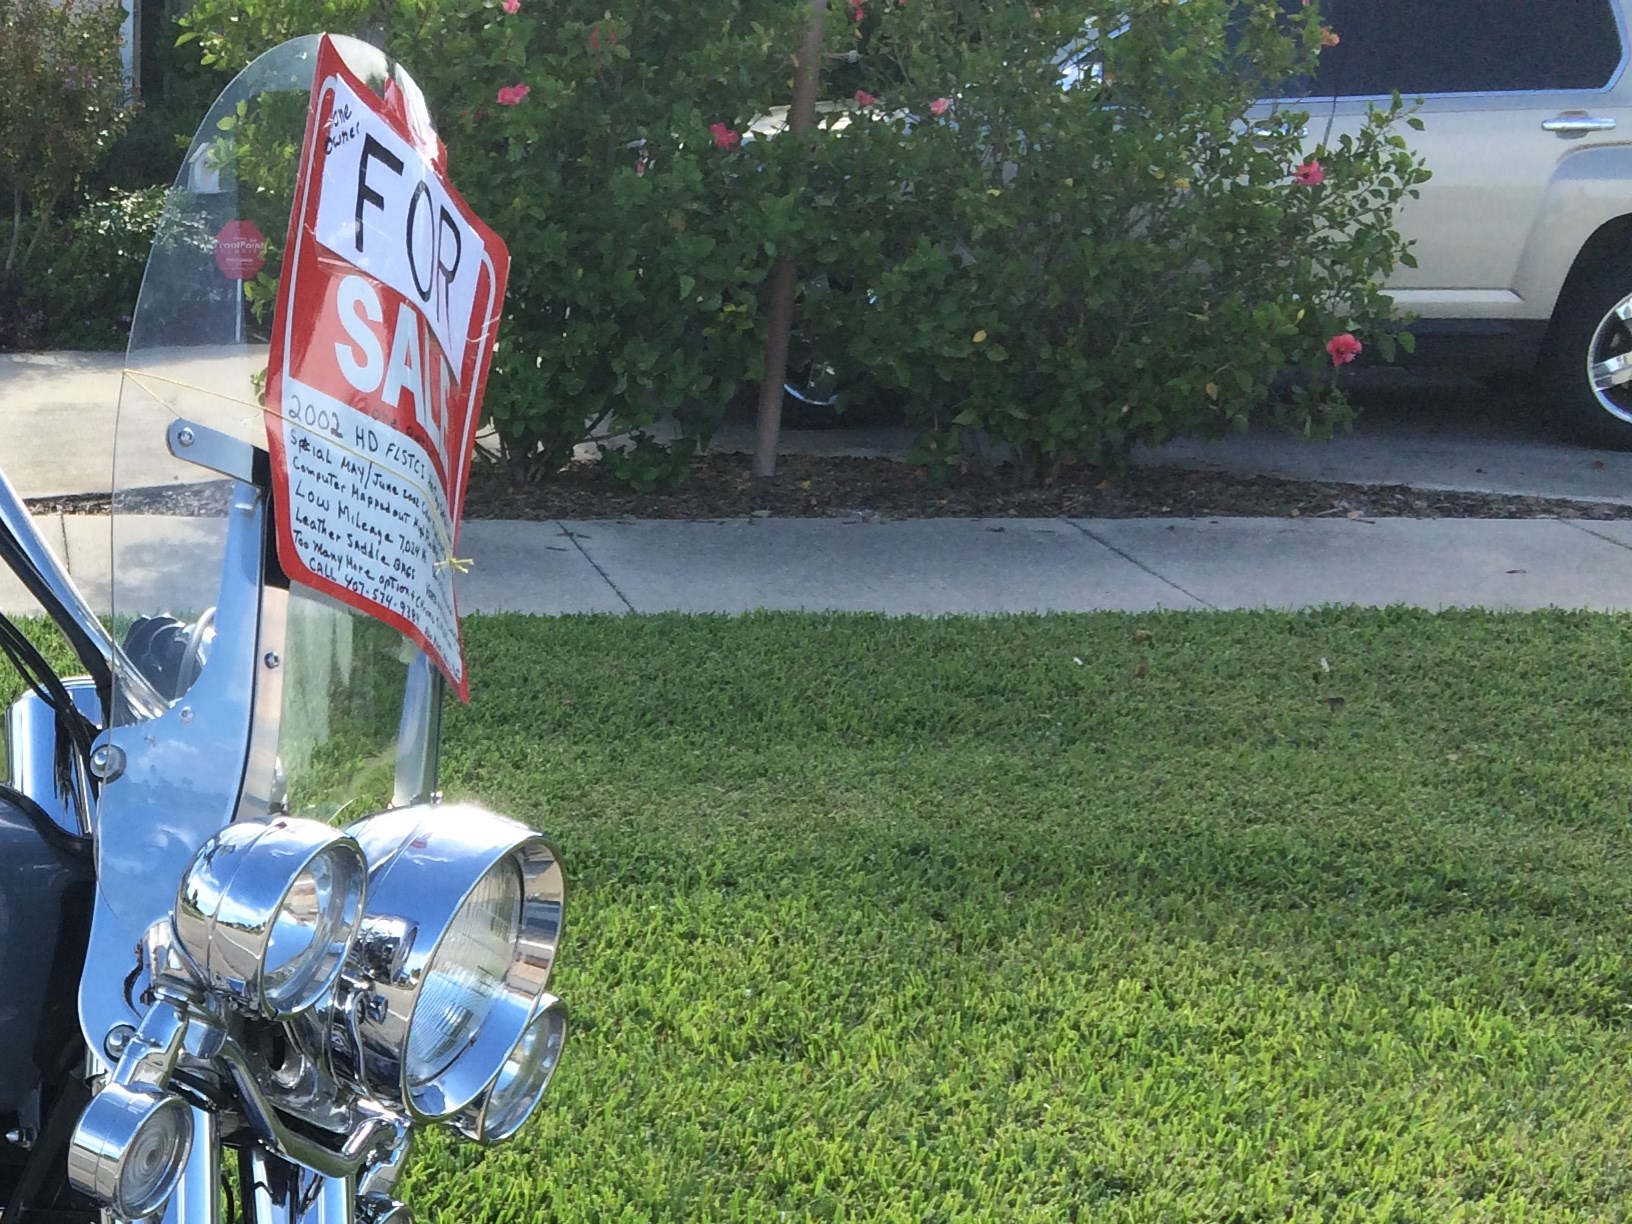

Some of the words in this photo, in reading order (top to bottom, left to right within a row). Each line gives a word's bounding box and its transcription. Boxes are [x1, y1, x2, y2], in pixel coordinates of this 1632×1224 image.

[355, 132, 462, 352] FOR
[288, 394, 344, 439] 2002
[355, 425, 379, 453] HD
[309, 556, 337, 582] CALL
